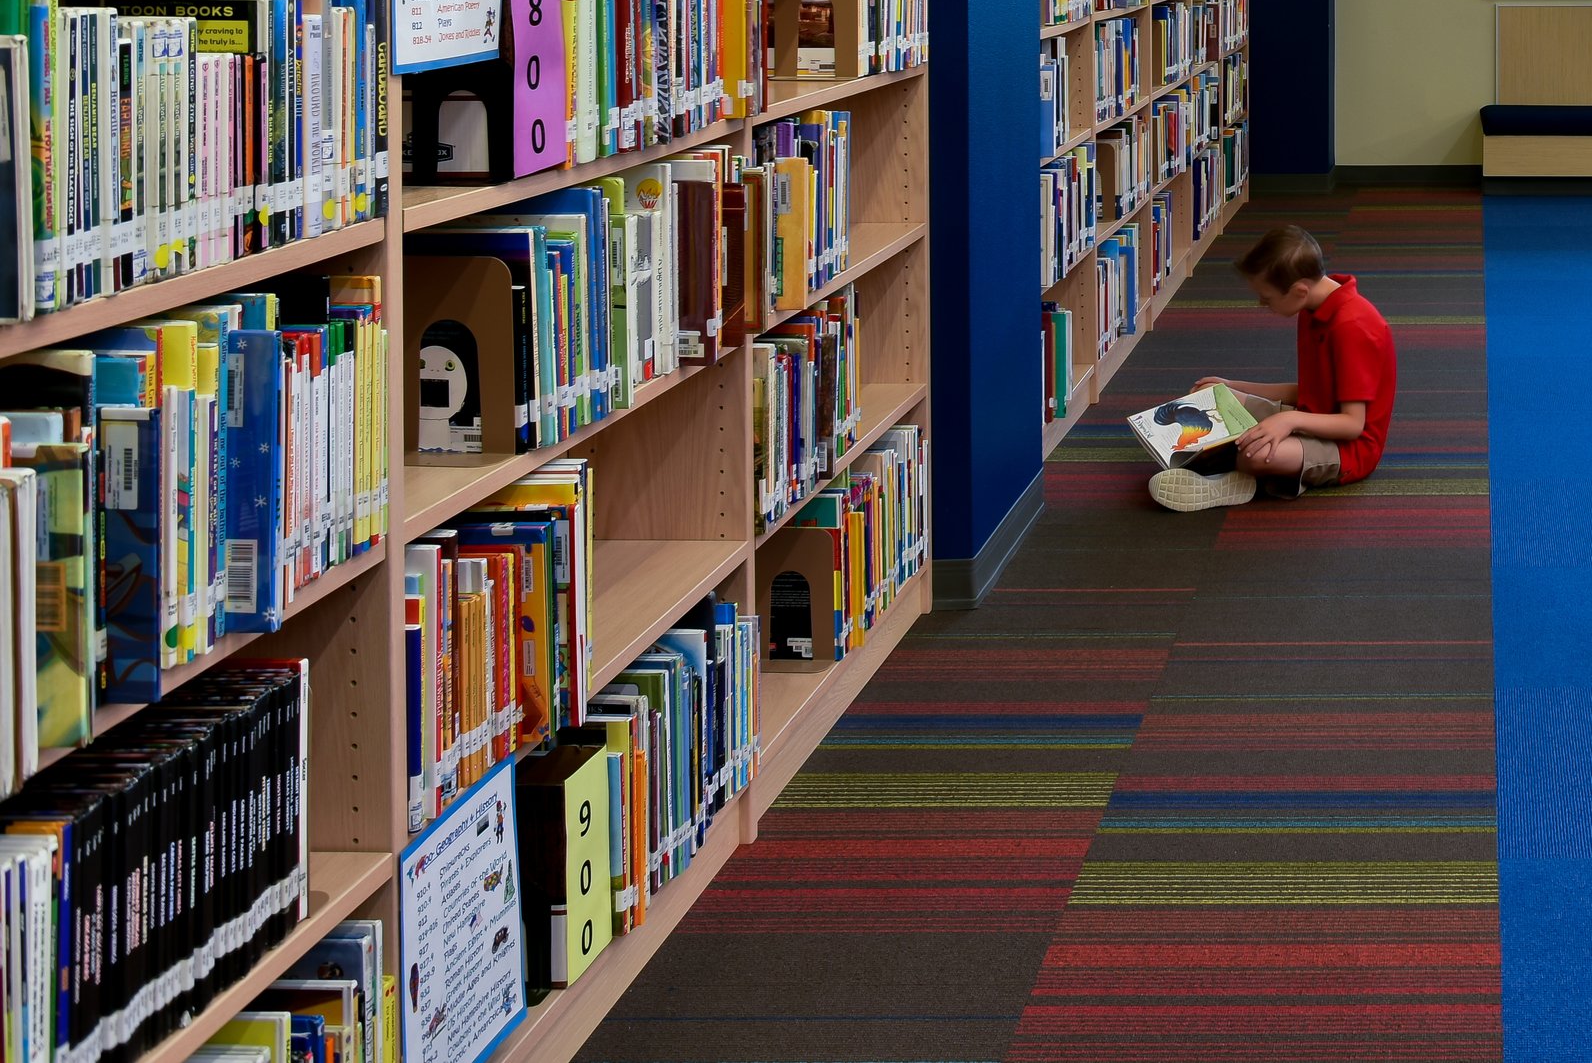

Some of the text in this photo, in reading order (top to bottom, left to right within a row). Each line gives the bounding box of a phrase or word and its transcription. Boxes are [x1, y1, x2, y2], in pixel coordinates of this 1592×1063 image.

[121, 4, 235, 18] TOON BOOKS
[411, 7, 422, 16] 811
[436, 3, 464, 14] American
[411, 17, 452, 30] 812 Plays
[205, 27, 244, 37] craving to
[438, 32, 455, 43] Jokes
[209, 37, 226, 48] truly
[147, 364, 156, 385] Nina
[218, 437, 227, 450] me
[218, 455, 227, 469] out
[218, 475, 227, 485] of
[218, 489, 227, 504] the
[218, 508, 227, 546] bathtub
[578, 800, 594, 956] 900
